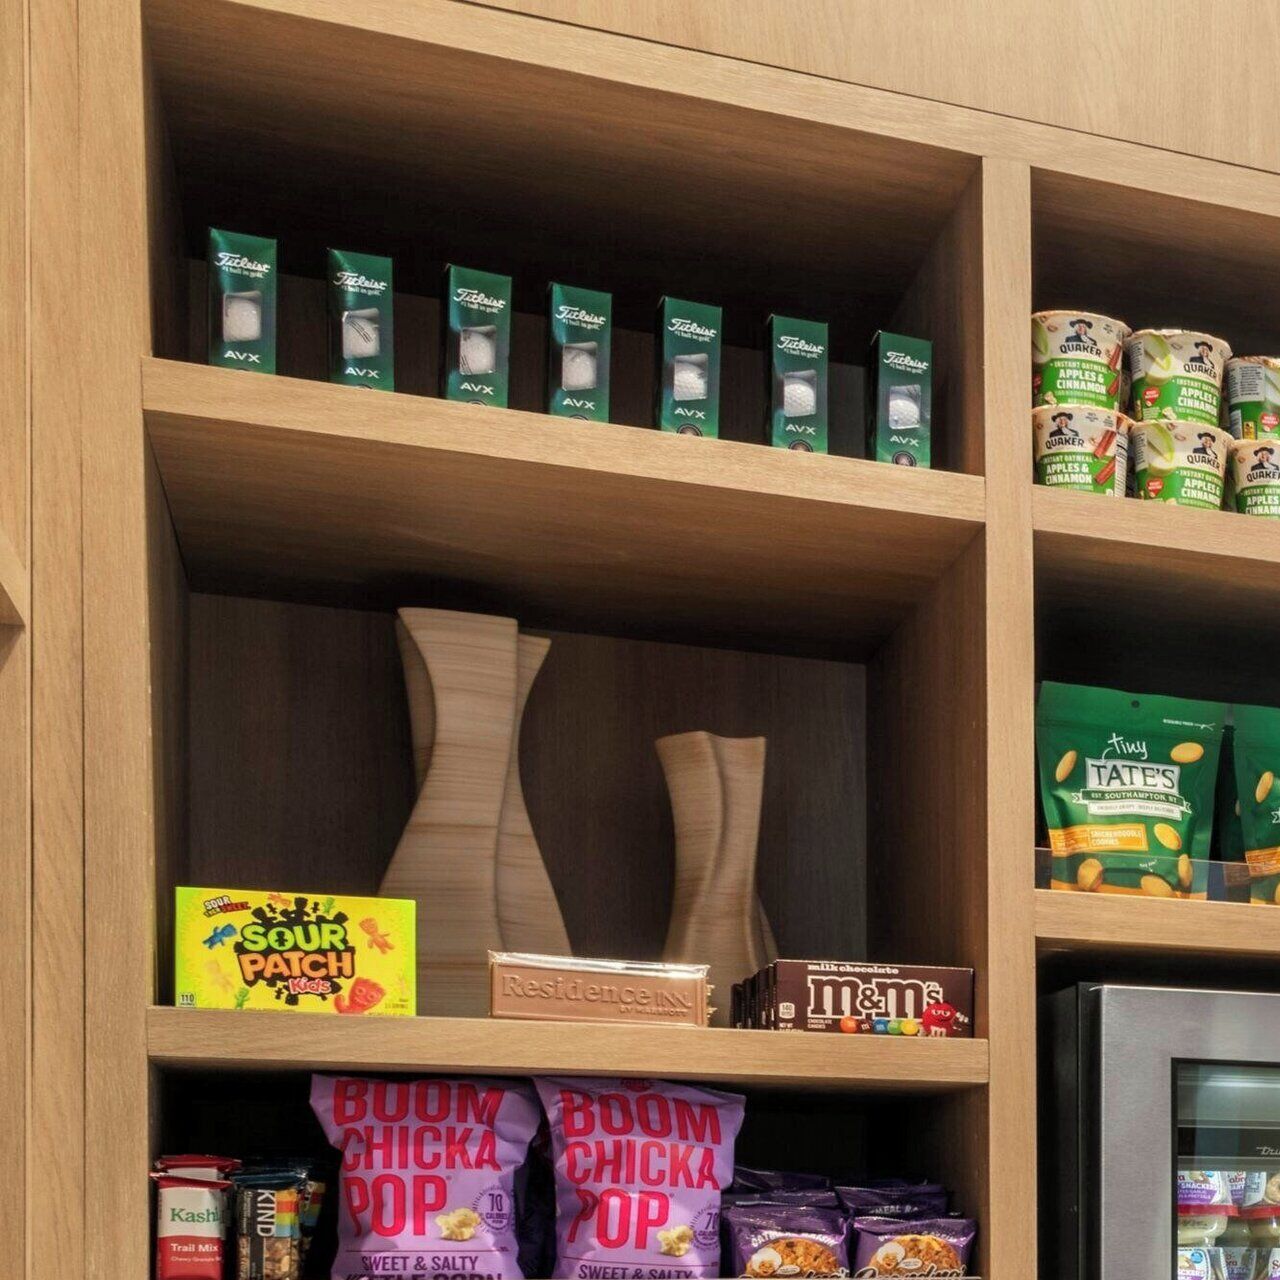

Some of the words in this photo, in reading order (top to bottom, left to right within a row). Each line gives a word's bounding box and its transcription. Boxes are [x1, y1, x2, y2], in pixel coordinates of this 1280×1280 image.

[215, 252, 271, 272] Titleist
[333, 271, 387, 290] Titleist
[453, 288, 506, 308] Titleist
[555, 305, 606, 324] Titleist
[668, 318, 717, 336] Titleist
[776, 335, 825, 353] Titleist
[1059, 342, 1102, 358] QUAKER
[223, 350, 261, 364] AVX
[883, 351, 929, 369] Titleist
[345, 367, 380, 379] AVX
[1184, 362, 1217, 379] QUAKER
[460, 382, 494, 395] AVX
[562, 397, 596, 411] AVX
[674, 406, 705, 420] AVX
[786, 422, 816, 436] AVX
[890, 435, 919, 448] AVX
[1045, 436, 1085, 450] QUAKER
[1187, 454, 1221, 470] QUAKER
[1107, 732, 1149, 760] tiny
[1091, 764, 1175, 790] TATE'S
[243, 923, 346, 951] SOUR
[239, 952, 354, 980] PATCH
[807, 964, 838, 972] milk
[839, 965, 899, 975] chocolate
[289, 978, 332, 994] Kids
[503, 974, 650, 1005] Residence
[657, 990, 692, 1008] INN
[333, 1079, 505, 1127] BOOM
[561, 1089, 721, 1145] BOOM
[343, 1125, 501, 1171] CHICKA
[565, 1140, 720, 1190] CHICKA
[257, 1189, 276, 1237] KIND
[344, 1174, 447, 1237] POP
[170, 1208, 221, 1223] Kashi
[568, 1188, 670, 1250] POP
[170, 1243, 195, 1252] Trail
[199, 1244, 218, 1252] Mix
[362, 1256, 411, 1272] SWEET
[415, 1257, 427, 1271] &
[431, 1255, 478, 1271] SALTY
